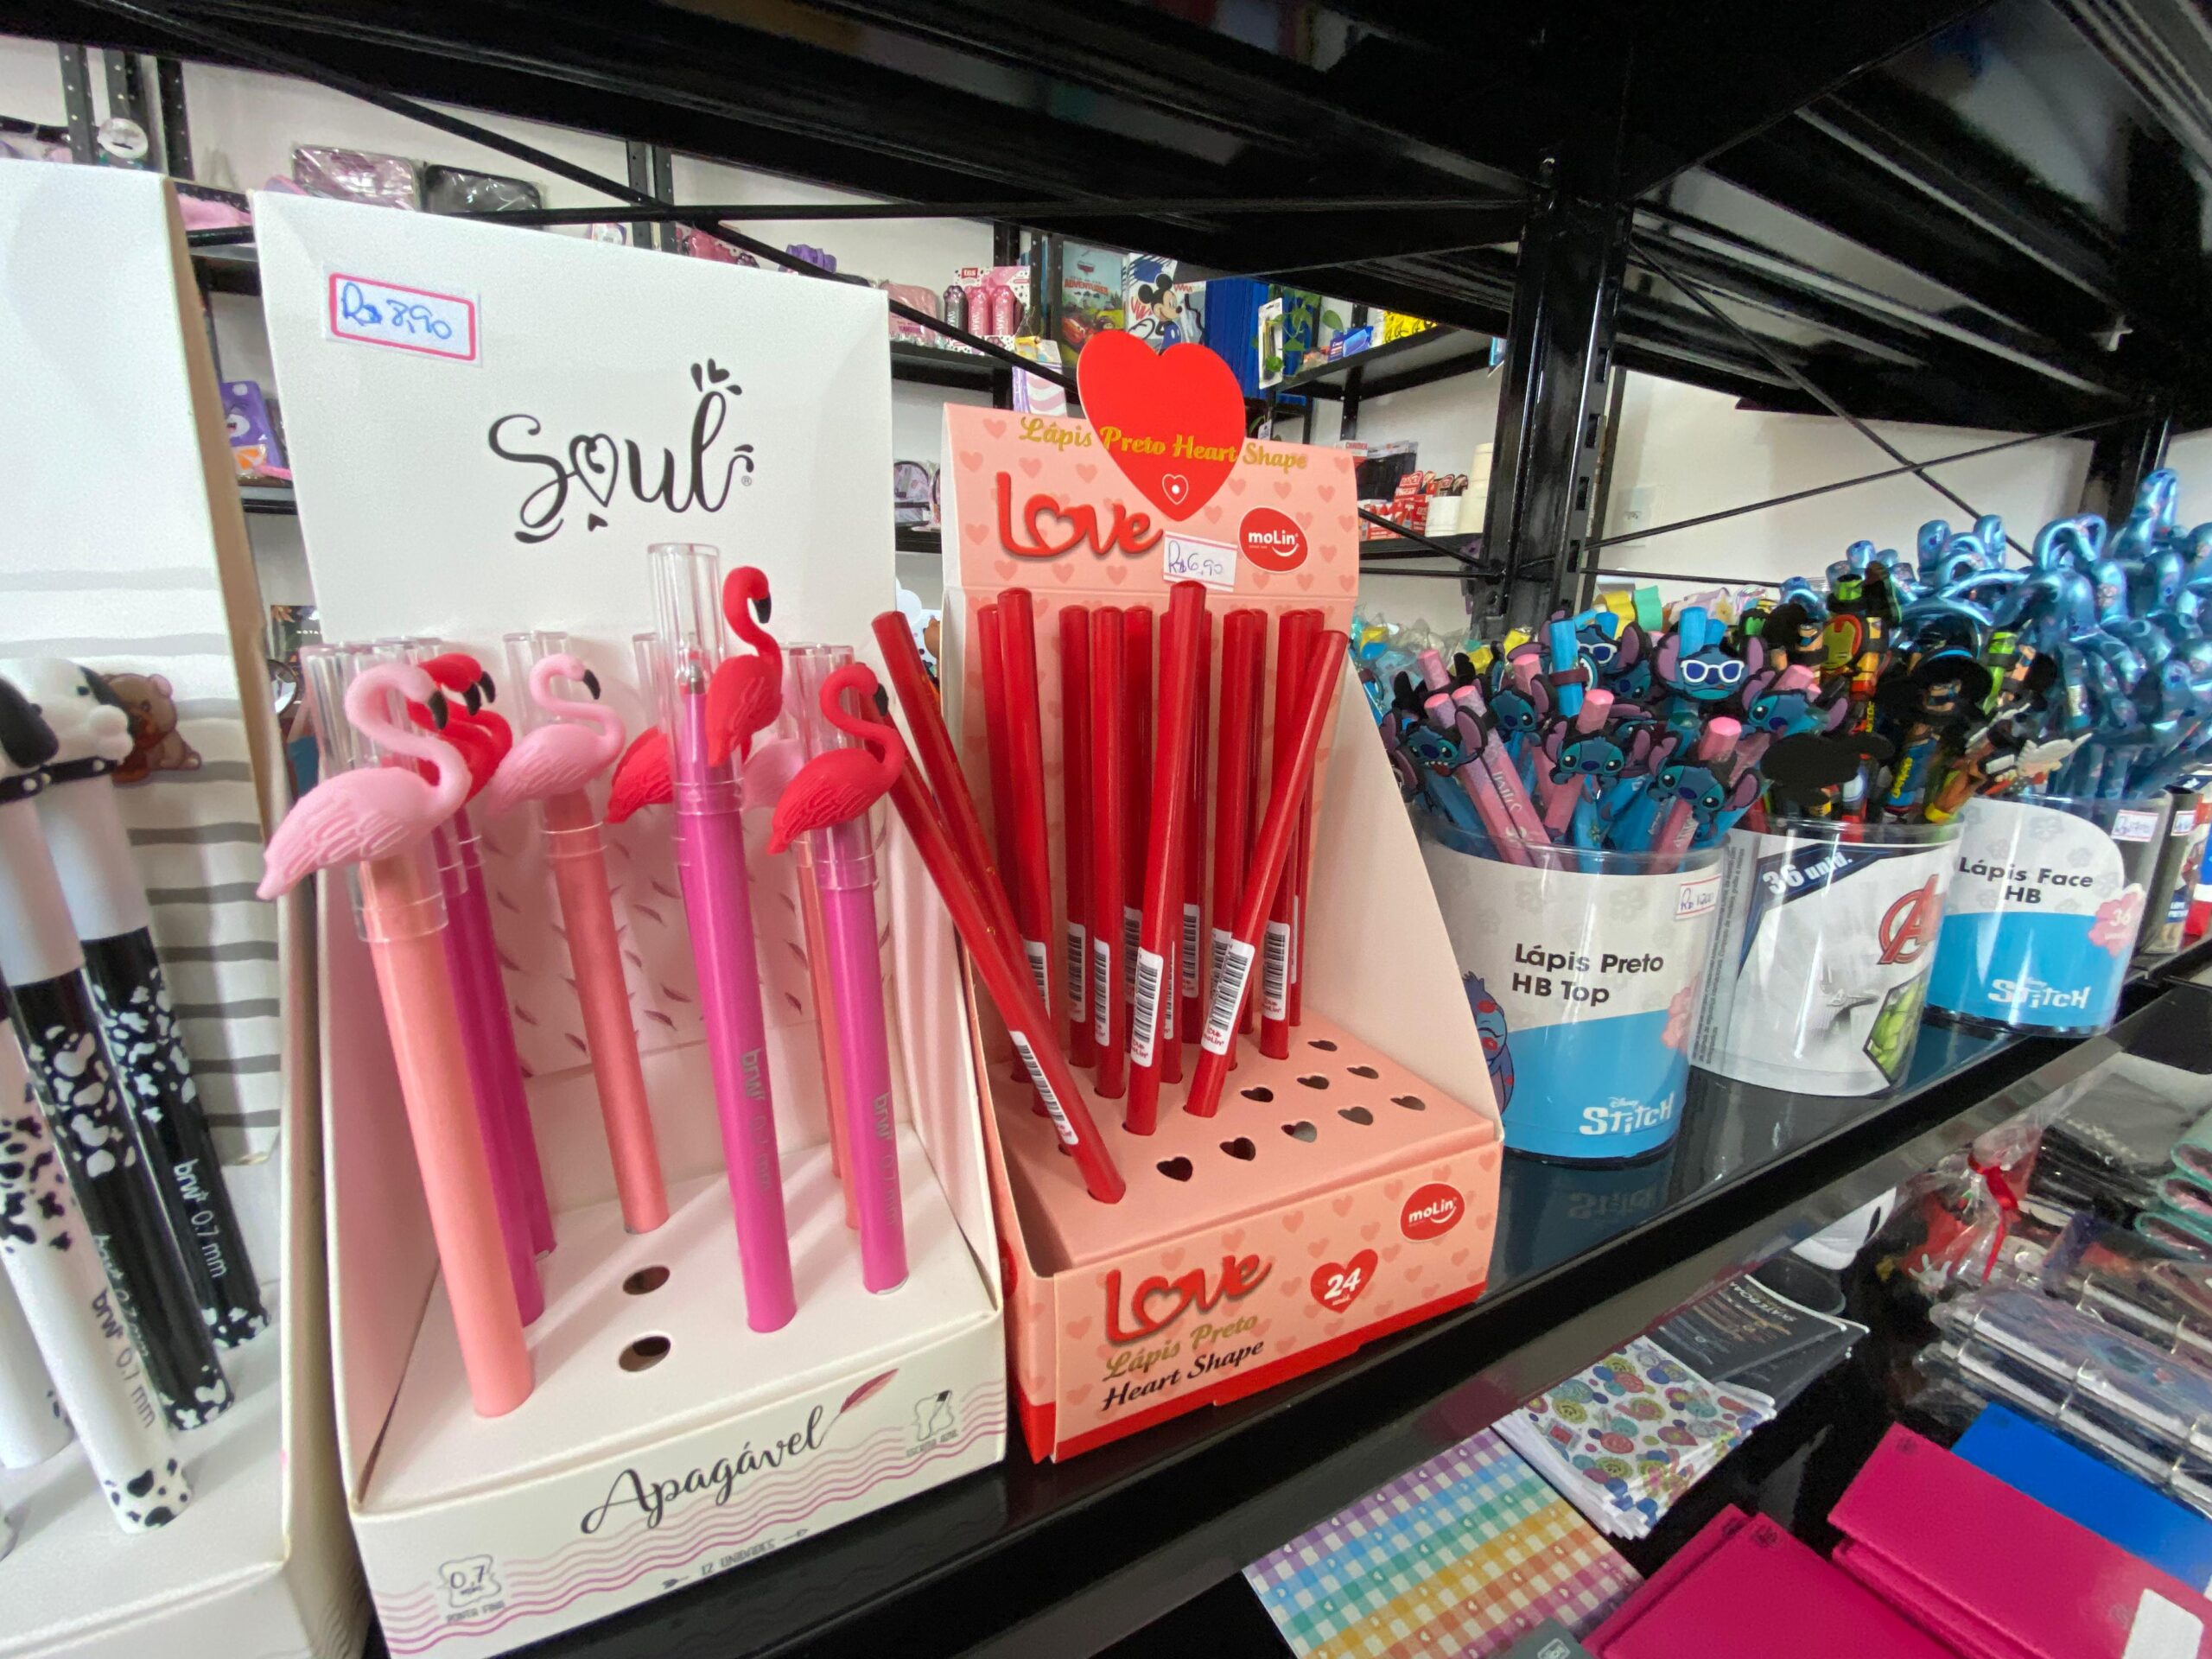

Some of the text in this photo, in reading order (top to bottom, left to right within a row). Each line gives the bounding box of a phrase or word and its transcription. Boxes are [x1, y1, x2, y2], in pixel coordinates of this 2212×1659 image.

[386, 299, 452, 340] 8,90
[1019, 416, 1307, 474] Lápis Preto Heart Shape
[1763, 864, 1805, 895] 36
[1959, 856, 2093, 888] Lápis Face
[2005, 885, 2042, 904] HB
[1516, 944, 1663, 973] Lápis Preto
[1512, 972, 1610, 1007] HB Top
[190, 1210, 219, 1236] 0.7
[202, 1243, 227, 1278] mm
[1324, 1267, 1362, 1300] 24
[1103, 1314, 1259, 1382] Lápis Preto
[116, 1347, 140, 1380] 0.7
[130, 1386, 156, 1428] mm
[1100, 1338, 1265, 1412] Heart Shape
[581, 1404, 826, 1535] Apagável
